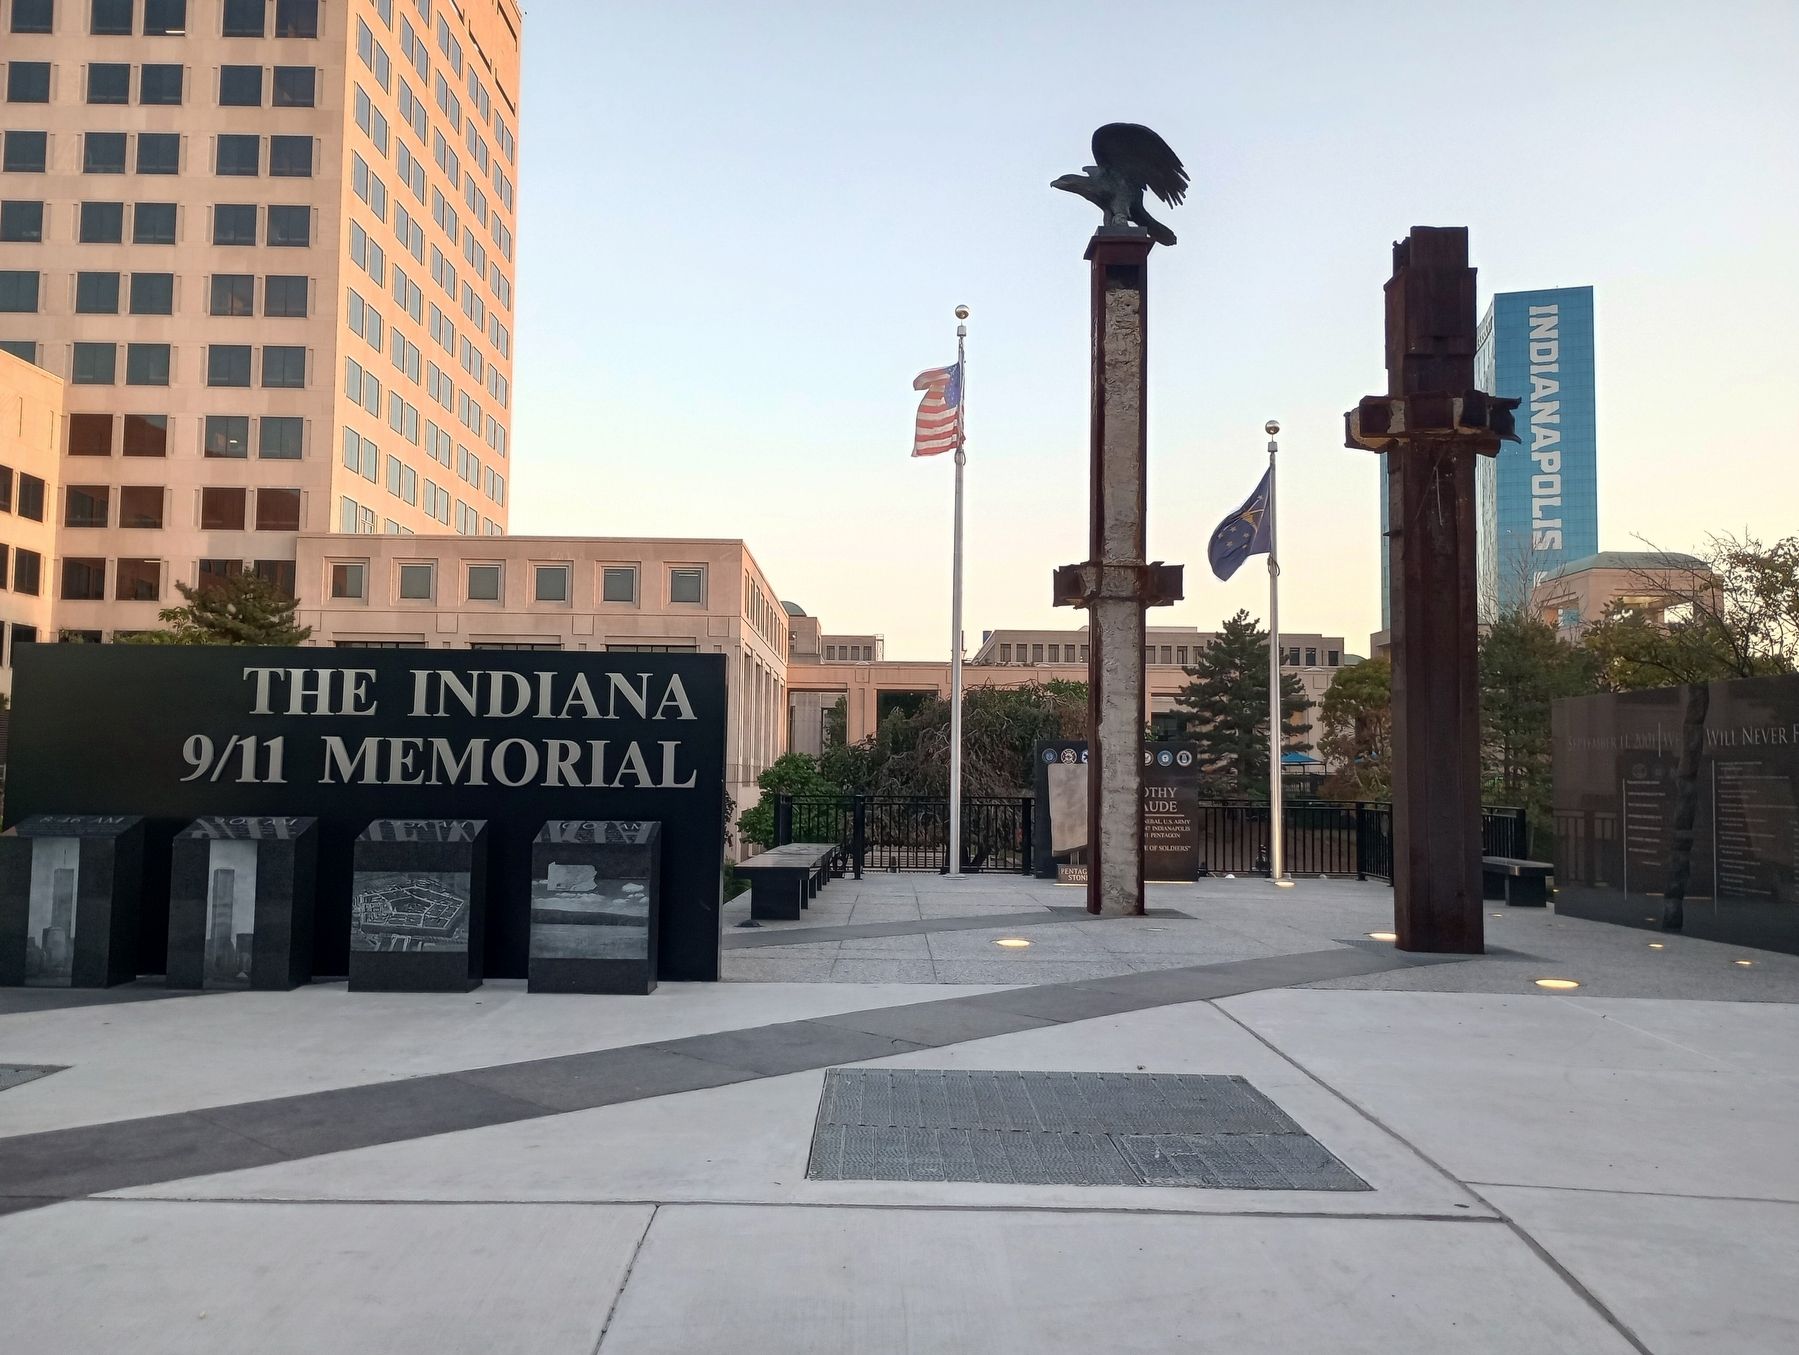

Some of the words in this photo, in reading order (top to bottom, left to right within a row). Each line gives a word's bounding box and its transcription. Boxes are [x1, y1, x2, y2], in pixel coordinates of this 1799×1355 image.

[1529, 303, 1562, 552] INDIANAPOLIS
[242, 667, 378, 716] THE
[407, 669, 698, 720] INDIANA
[179, 733, 288, 784] 9/11
[317, 735, 698, 789] MEMORIAL
[1705, 727, 1736, 746] WILL
[1742, 725, 1787, 745] NEVER
